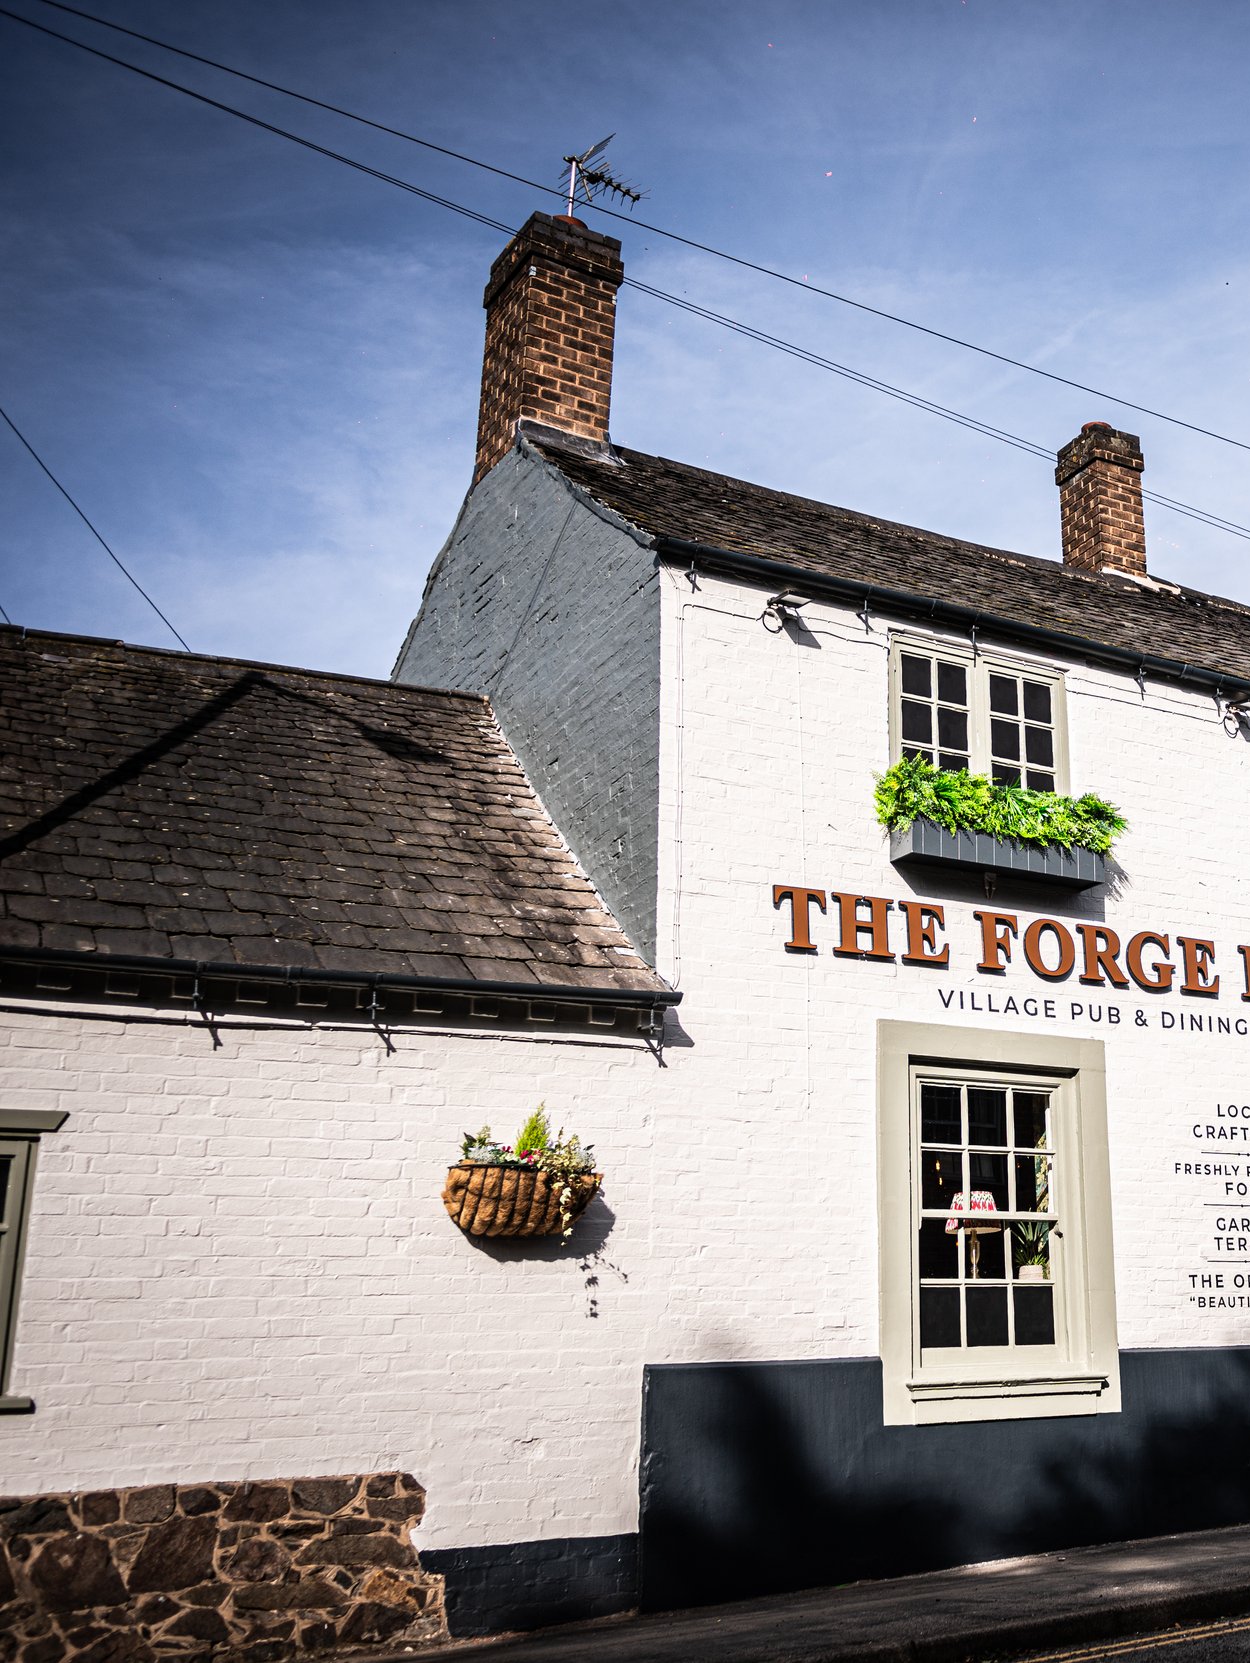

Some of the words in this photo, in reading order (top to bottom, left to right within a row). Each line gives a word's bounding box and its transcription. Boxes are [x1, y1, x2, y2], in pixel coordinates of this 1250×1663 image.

[772, 884, 950, 966] THE
[974, 911, 1220, 997] FORGE
[938, 989, 1056, 1019] VILLAGE
[1071, 1004, 1122, 1025] PUB
[1135, 1010, 1149, 1028] &
[1162, 1012, 1249, 1036] DINING
[1193, 1124, 1249, 1141] CRAFT
[1175, 1163, 1240, 1176] FRESHLY
[1189, 1274, 1225, 1288] THE
